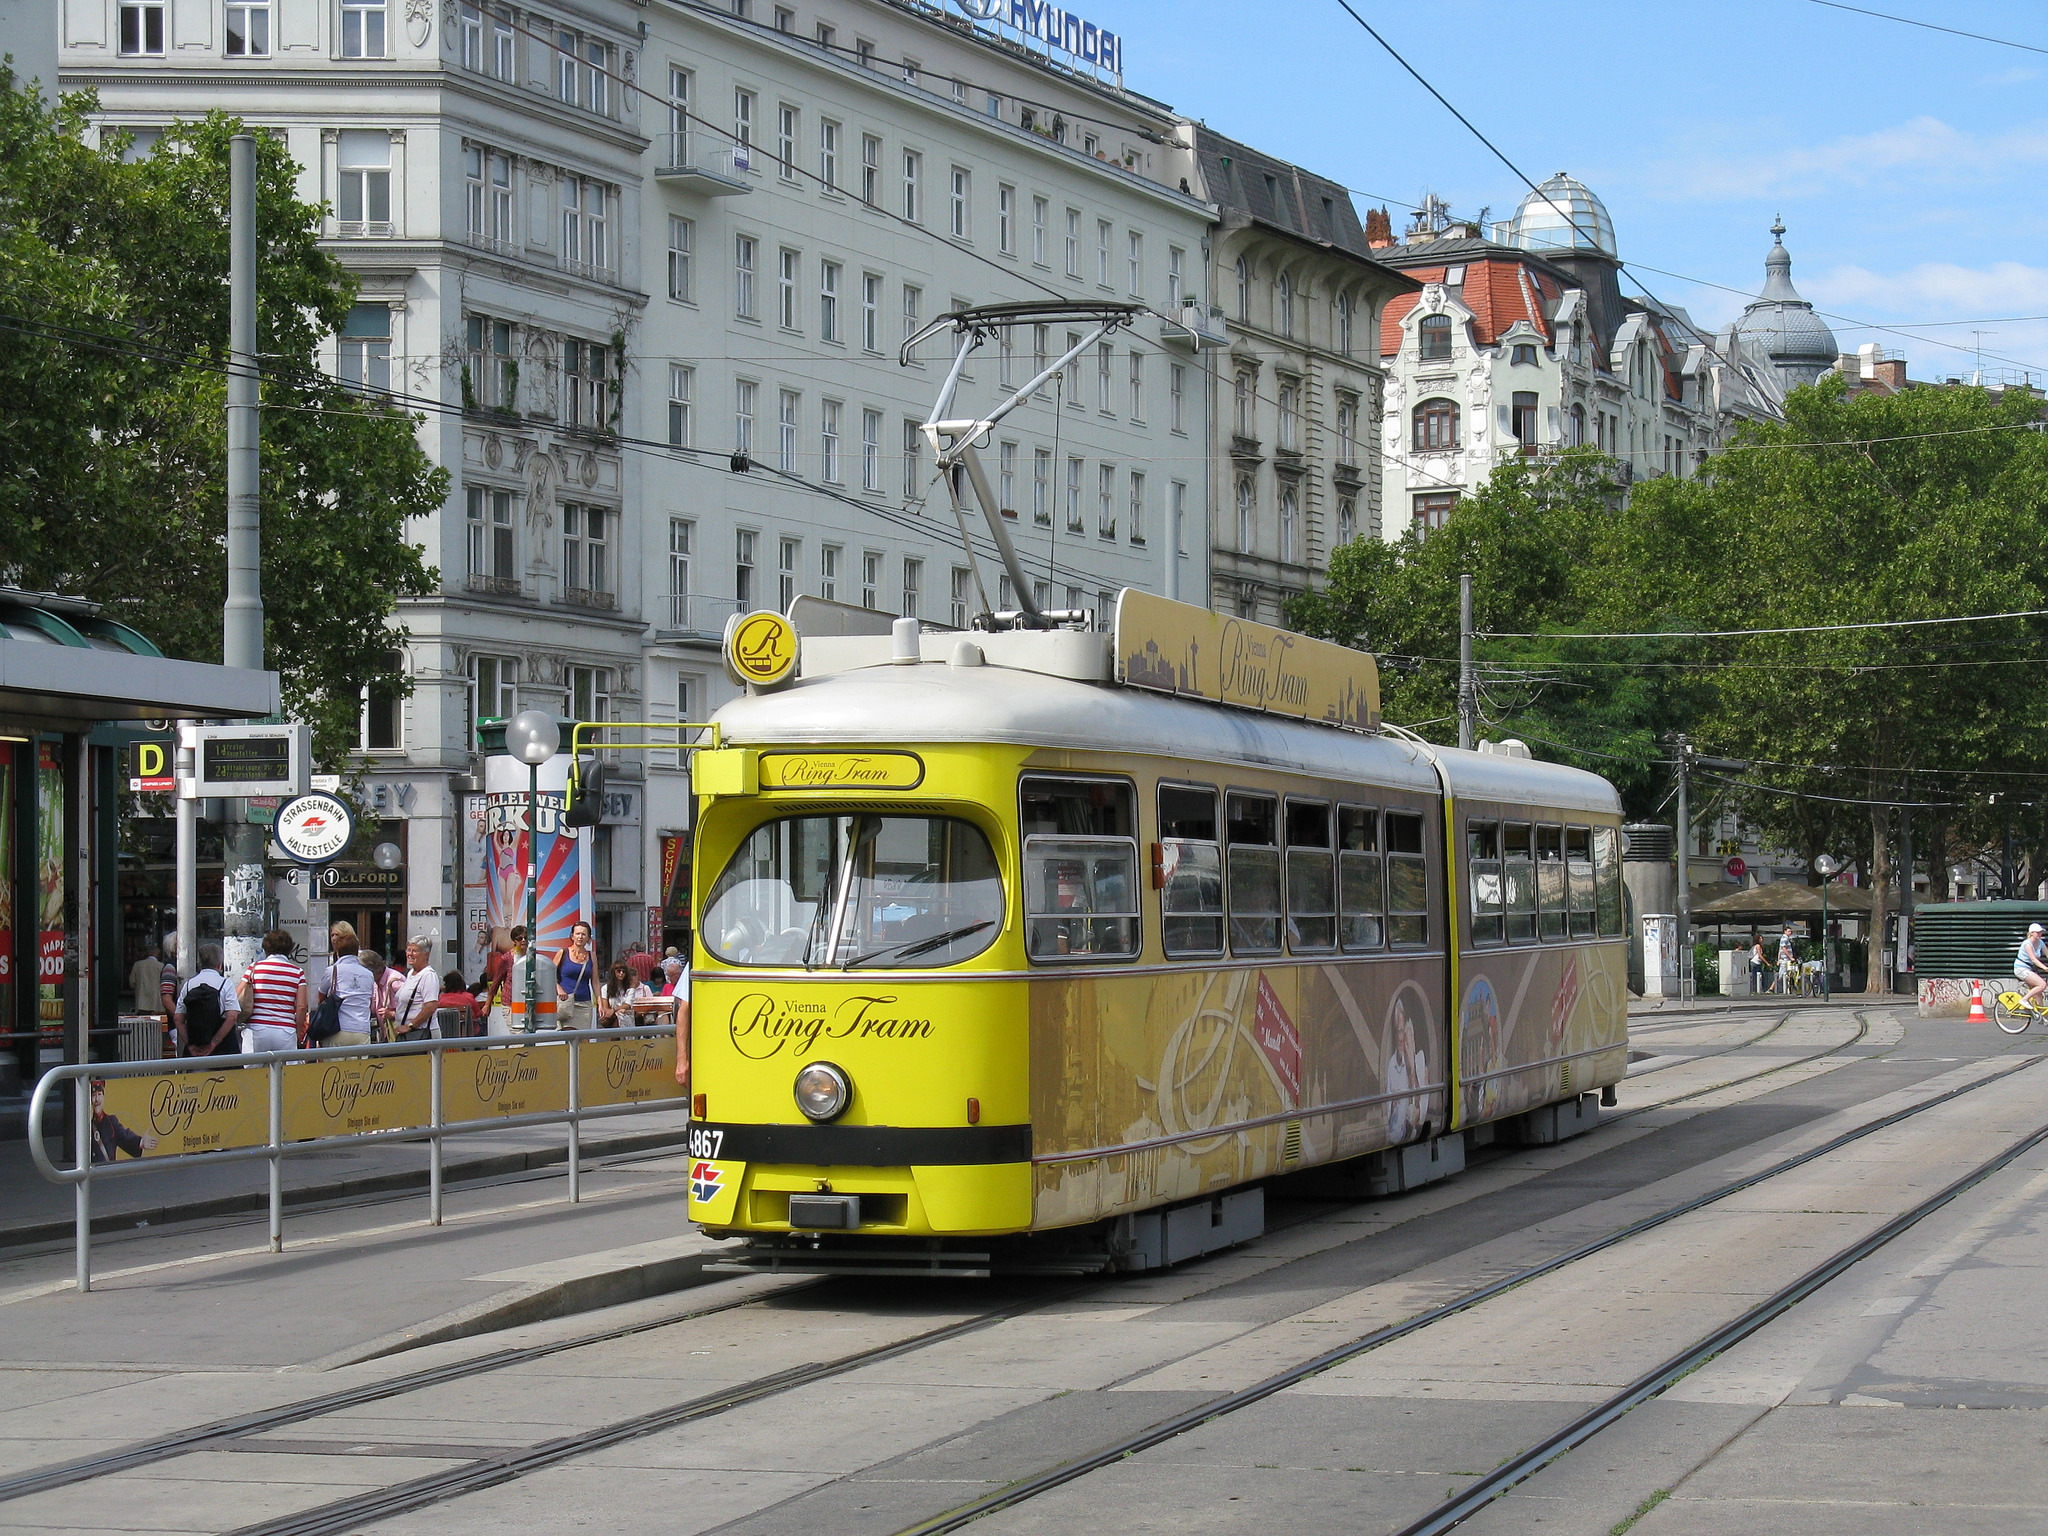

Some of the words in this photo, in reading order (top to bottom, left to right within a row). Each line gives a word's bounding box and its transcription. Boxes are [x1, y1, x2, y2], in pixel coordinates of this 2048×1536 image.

[1008, 0, 1122, 74] HYUNDAI
[1246, 634, 1266, 658] Vienna
[1220, 619, 1265, 707] Ring
[1266, 634, 1309, 706] Tram
[139, 744, 164, 776] D
[782, 758, 834, 785] Ring
[834, 758, 889, 780] Tram
[284, 800, 344, 824] STRASSENBAHN
[286, 834, 342, 856] HALTESTELLE
[328, 870, 334, 884] 1
[340, 872, 398, 883] ELFORD
[784, 1000, 826, 1013] Vienna
[730, 994, 825, 1060] Ring
[826, 996, 935, 1039] Tram
[476, 1054, 508, 1102] Ring
[508, 1052, 538, 1083] Tram
[607, 1045, 636, 1089] Ring
[636, 1043, 662, 1072] Tram
[179, 1084, 198, 1094] Vienna
[322, 1066, 360, 1118] Ring
[360, 1063, 395, 1097] Tram
[150, 1080, 198, 1136] Ring
[198, 1076, 240, 1113] Tram
[183, 1136, 202, 1148] Steigen
[202, 1134, 210, 1144] Sie
[688, 1130, 724, 1159] 4867
